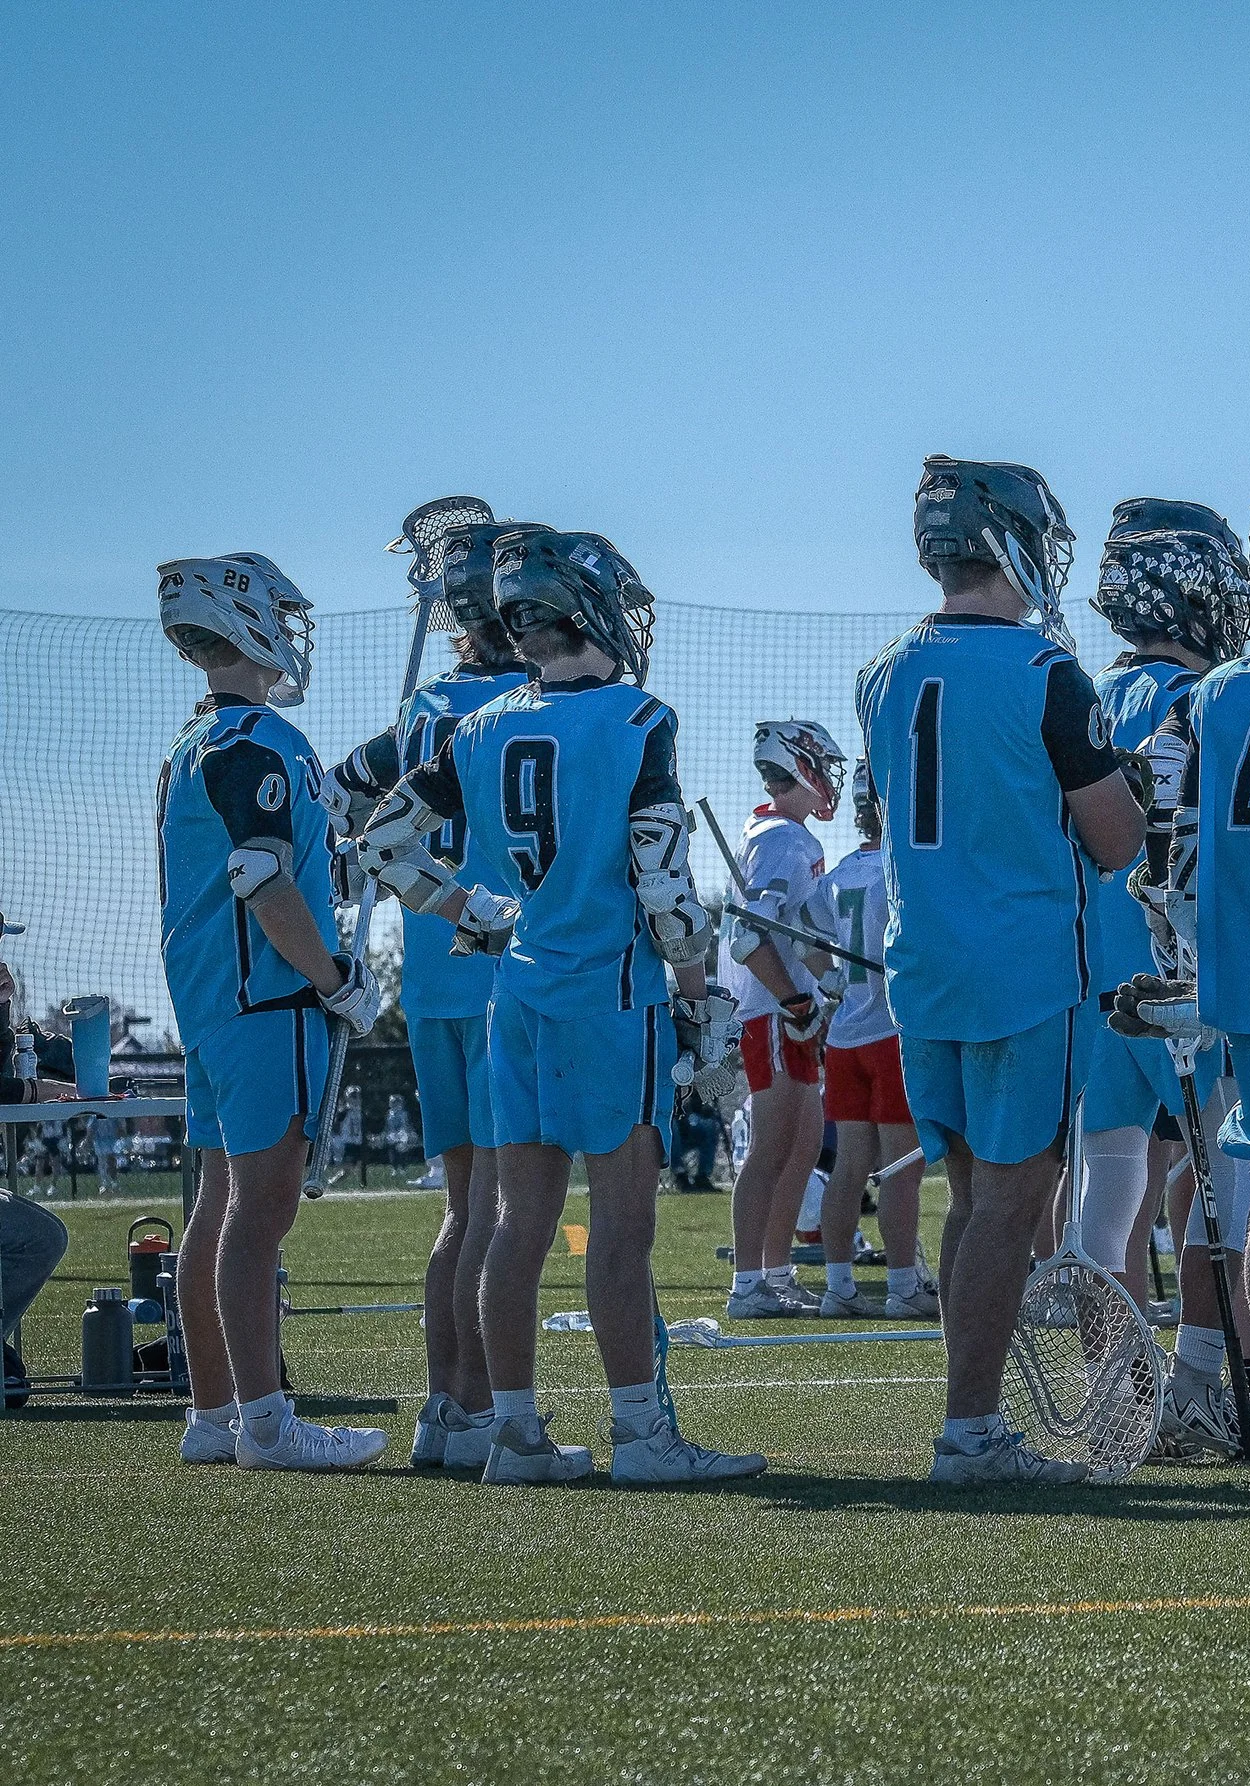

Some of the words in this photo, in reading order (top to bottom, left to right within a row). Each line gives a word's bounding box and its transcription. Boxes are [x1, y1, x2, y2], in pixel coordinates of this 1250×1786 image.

[223, 568, 250, 593] 28
[909, 677, 944, 850] 1
[1152, 774, 1173, 785] TX
[500, 734, 561, 896] 9
[838, 886, 868, 984] 7
